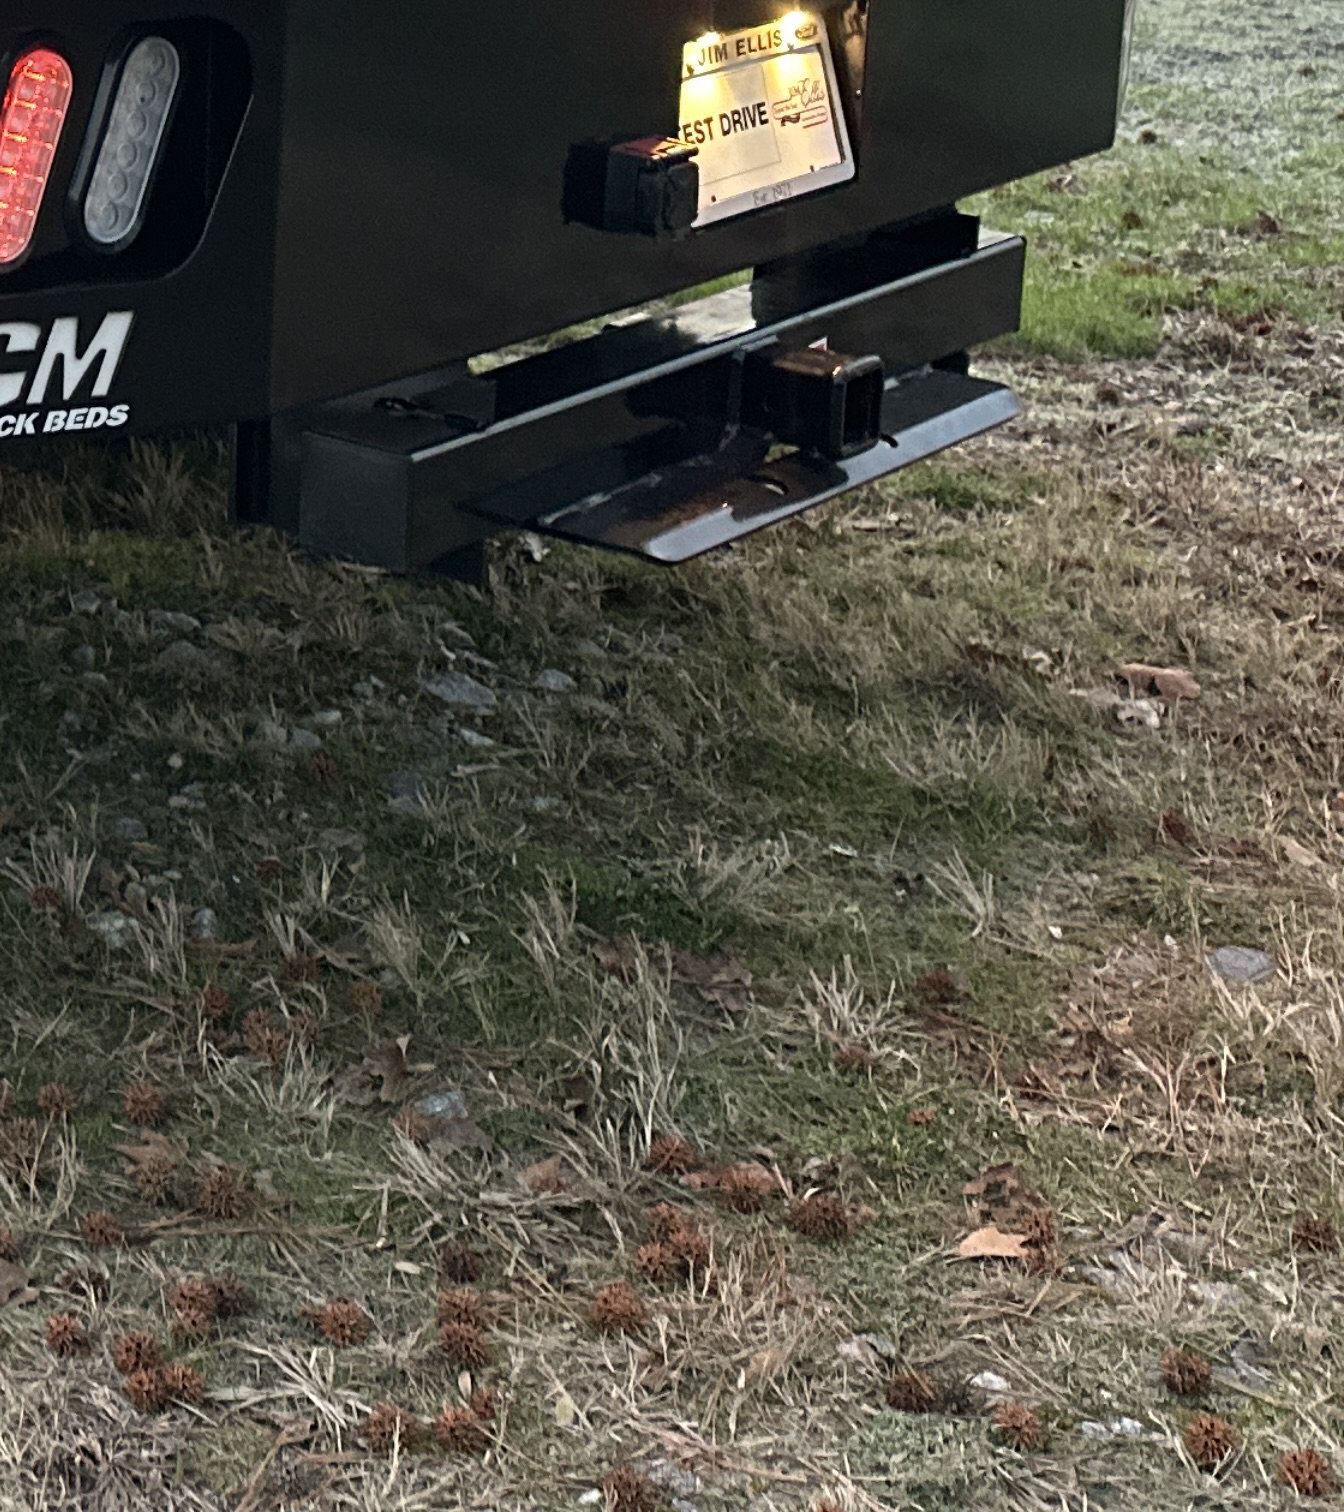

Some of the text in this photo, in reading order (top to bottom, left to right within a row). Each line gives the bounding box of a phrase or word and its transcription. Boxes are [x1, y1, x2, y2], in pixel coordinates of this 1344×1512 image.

[697, 42, 729, 67] JIM
[735, 28, 783, 56] ELLIS
[677, 116, 714, 145] EST
[718, 101, 769, 137] DRIVE
[42, 404, 131, 434] BEDS
